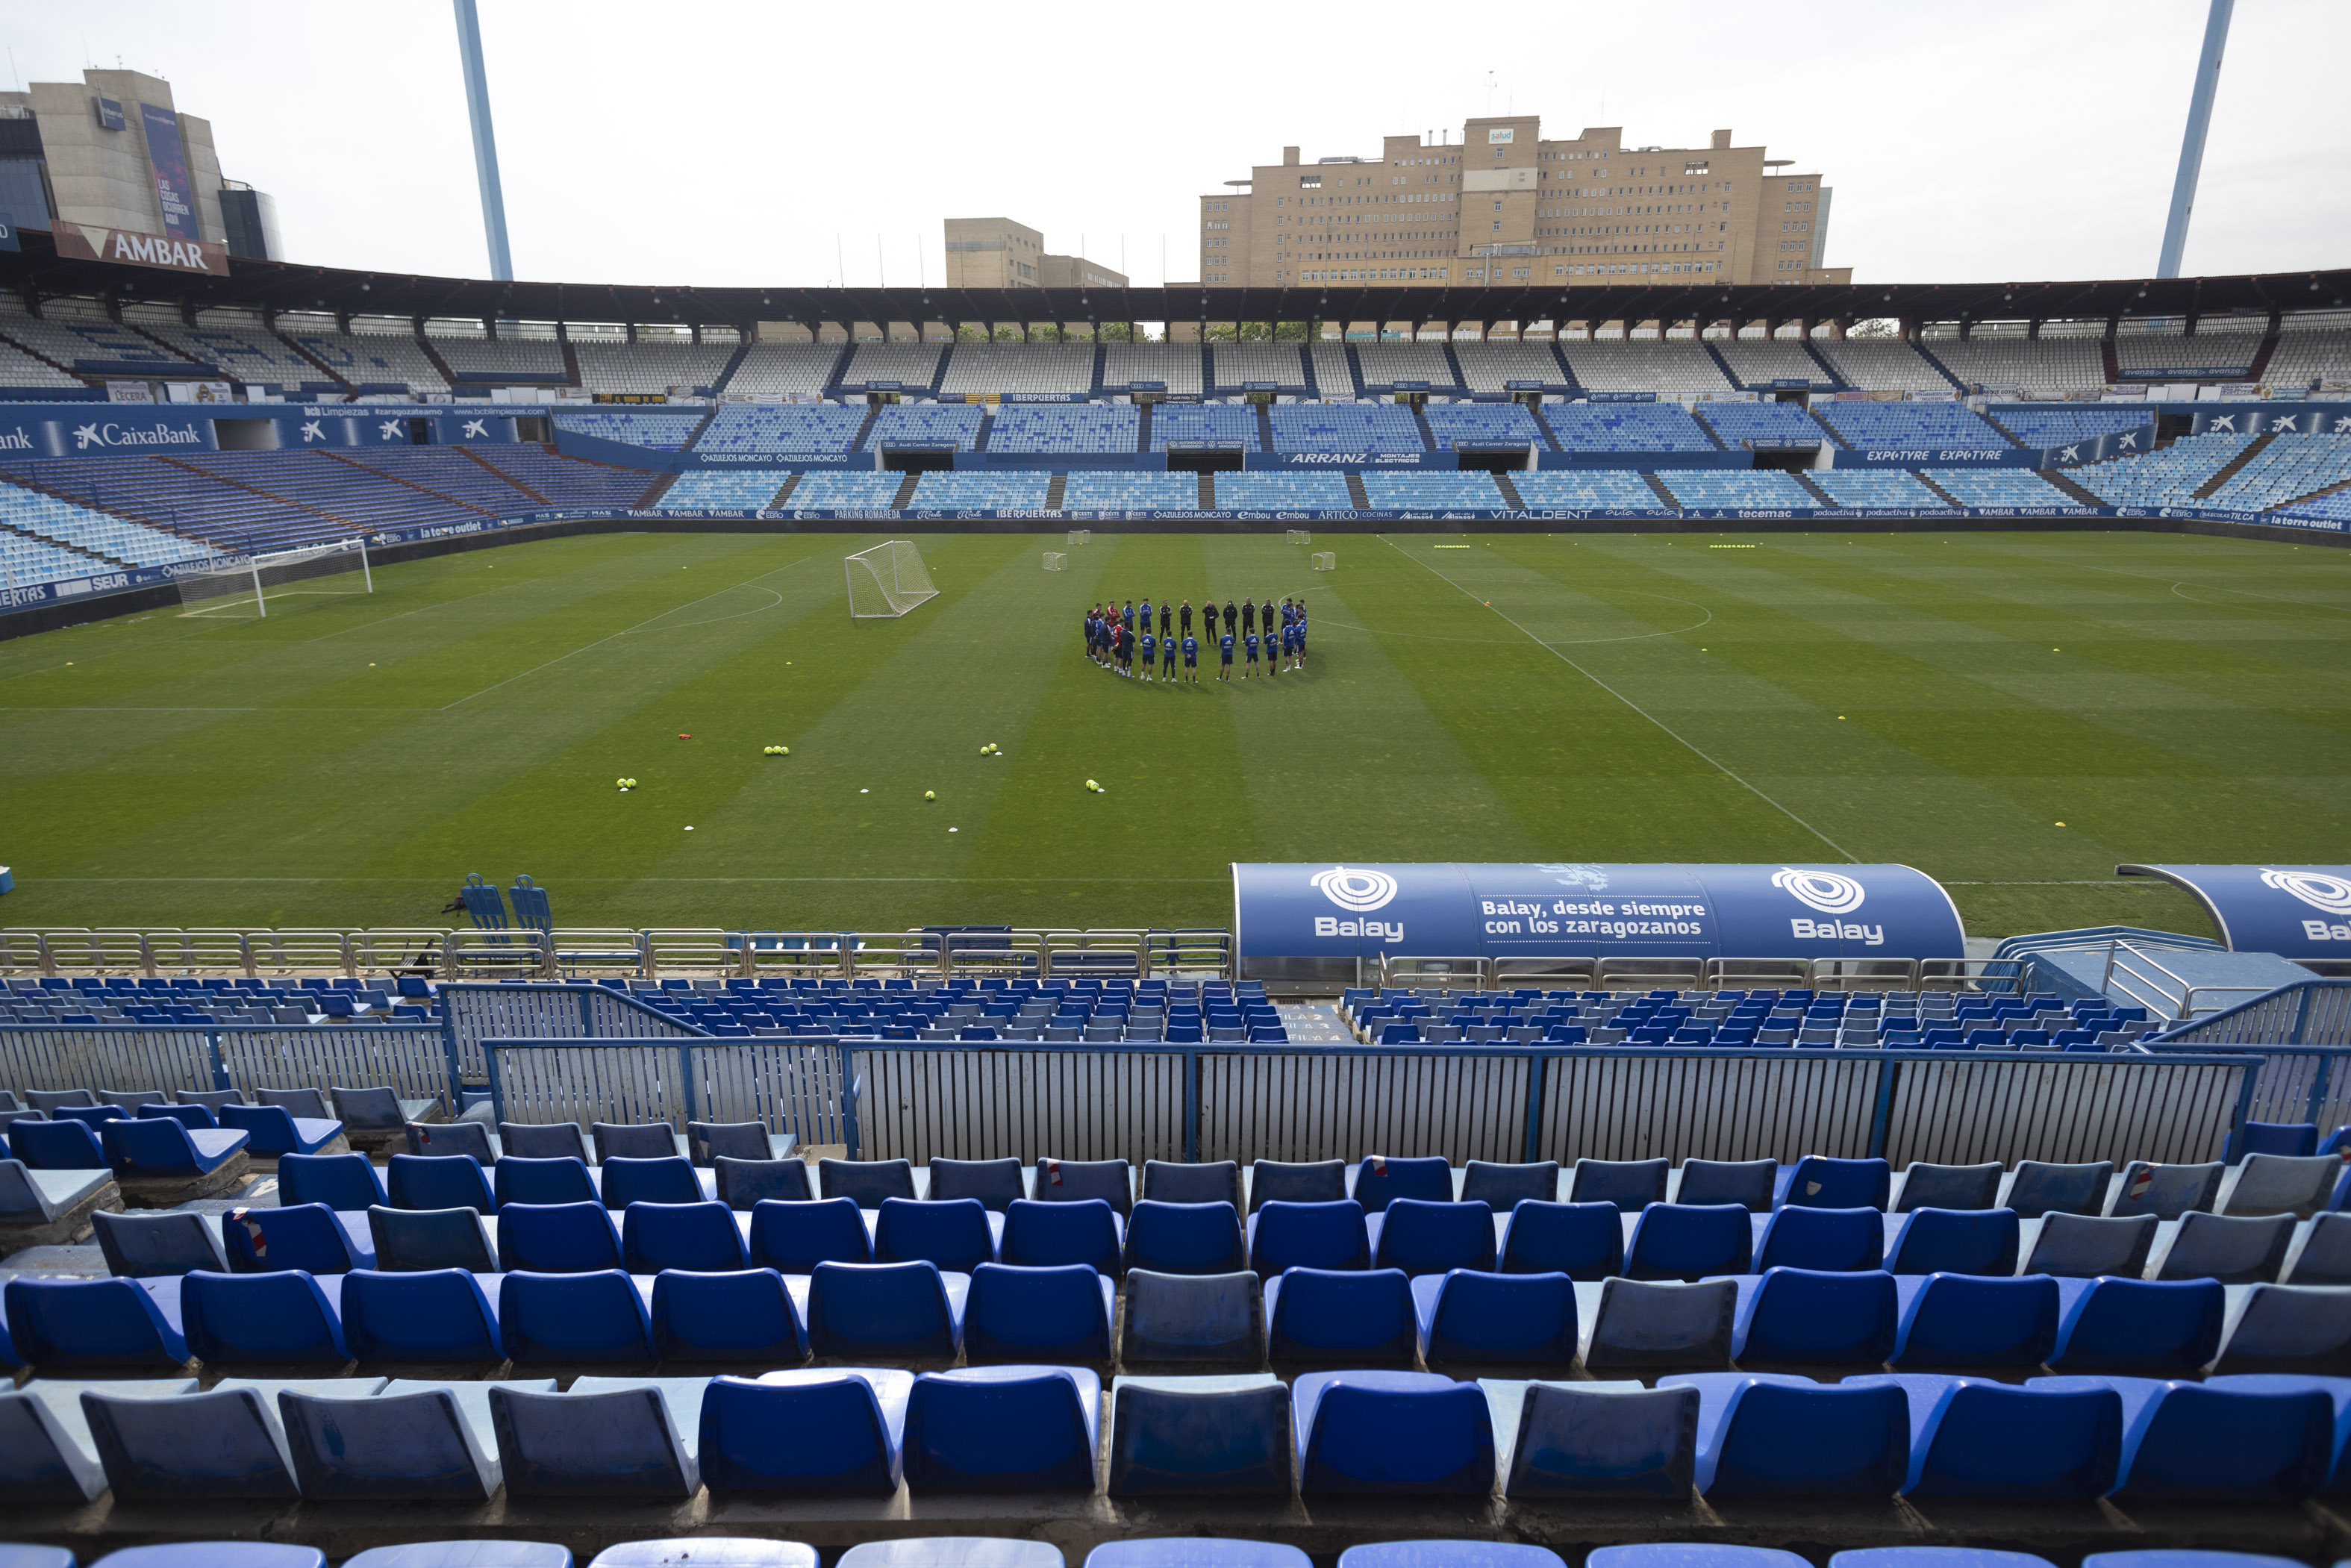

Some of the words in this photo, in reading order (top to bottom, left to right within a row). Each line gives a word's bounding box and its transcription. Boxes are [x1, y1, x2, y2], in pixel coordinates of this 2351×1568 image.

[1491, 131, 1511, 140] salud
[158, 179, 170, 190] LAS
[160, 190, 179, 203] COSAS
[163, 202, 190, 216] OCURREN
[115, 234, 208, 269] AMBAR
[304, 407, 321, 416] bcb
[321, 407, 369, 418] Limpiezas
[375, 408, 443, 416] #zaragozateamo
[454, 407, 546, 416] www.bcblimpiezas.com
[102, 423, 201, 446] CaixaBank
[1290, 454, 1368, 463] ARRANZ
[834, 510, 864, 519] PARKING
[864, 510, 901, 519] ROMAREDA
[996, 510, 1063, 519] IBERPUERTAS
[1237, 510, 1270, 519] embou
[1276, 510, 1309, 519] embou
[1318, 510, 1358, 519] ARTICO
[1490, 510, 1593, 519] VITALDENT
[1738, 509, 1792, 518] tecemac
[1813, 509, 1855, 518] podoactiva
[1866, 509, 1908, 518] podoactiva
[1920, 508, 1961, 517] podoactiva
[2067, 507, 2099, 516] AMBAR
[2202, 510, 2230, 519] BÁSCULAS
[2230, 512, 2254, 521] TILCA
[2270, 516, 2282, 524] la
[2282, 516, 2308, 526] torre
[2309, 519, 2343, 530] outlet
[420, 528, 431, 538] la
[431, 526, 454, 537] toe
[455, 521, 481, 534] outlet
[172, 560, 210, 575] AZULEJOS
[93, 574, 128, 591] SEUR
[0, 586, 46, 607] ERTAS
[1482, 900, 1547, 919] Balay,
[1553, 900, 1614, 916] desde
[1621, 901, 1706, 919] siempre
[1314, 916, 1404, 943] Balay
[1484, 920, 1520, 934] con
[1529, 918, 1559, 934] los
[1565, 920, 1702, 938] zaragozanos
[1790, 919, 1885, 945] Balay
[2301, 920, 2351, 940] Ba
